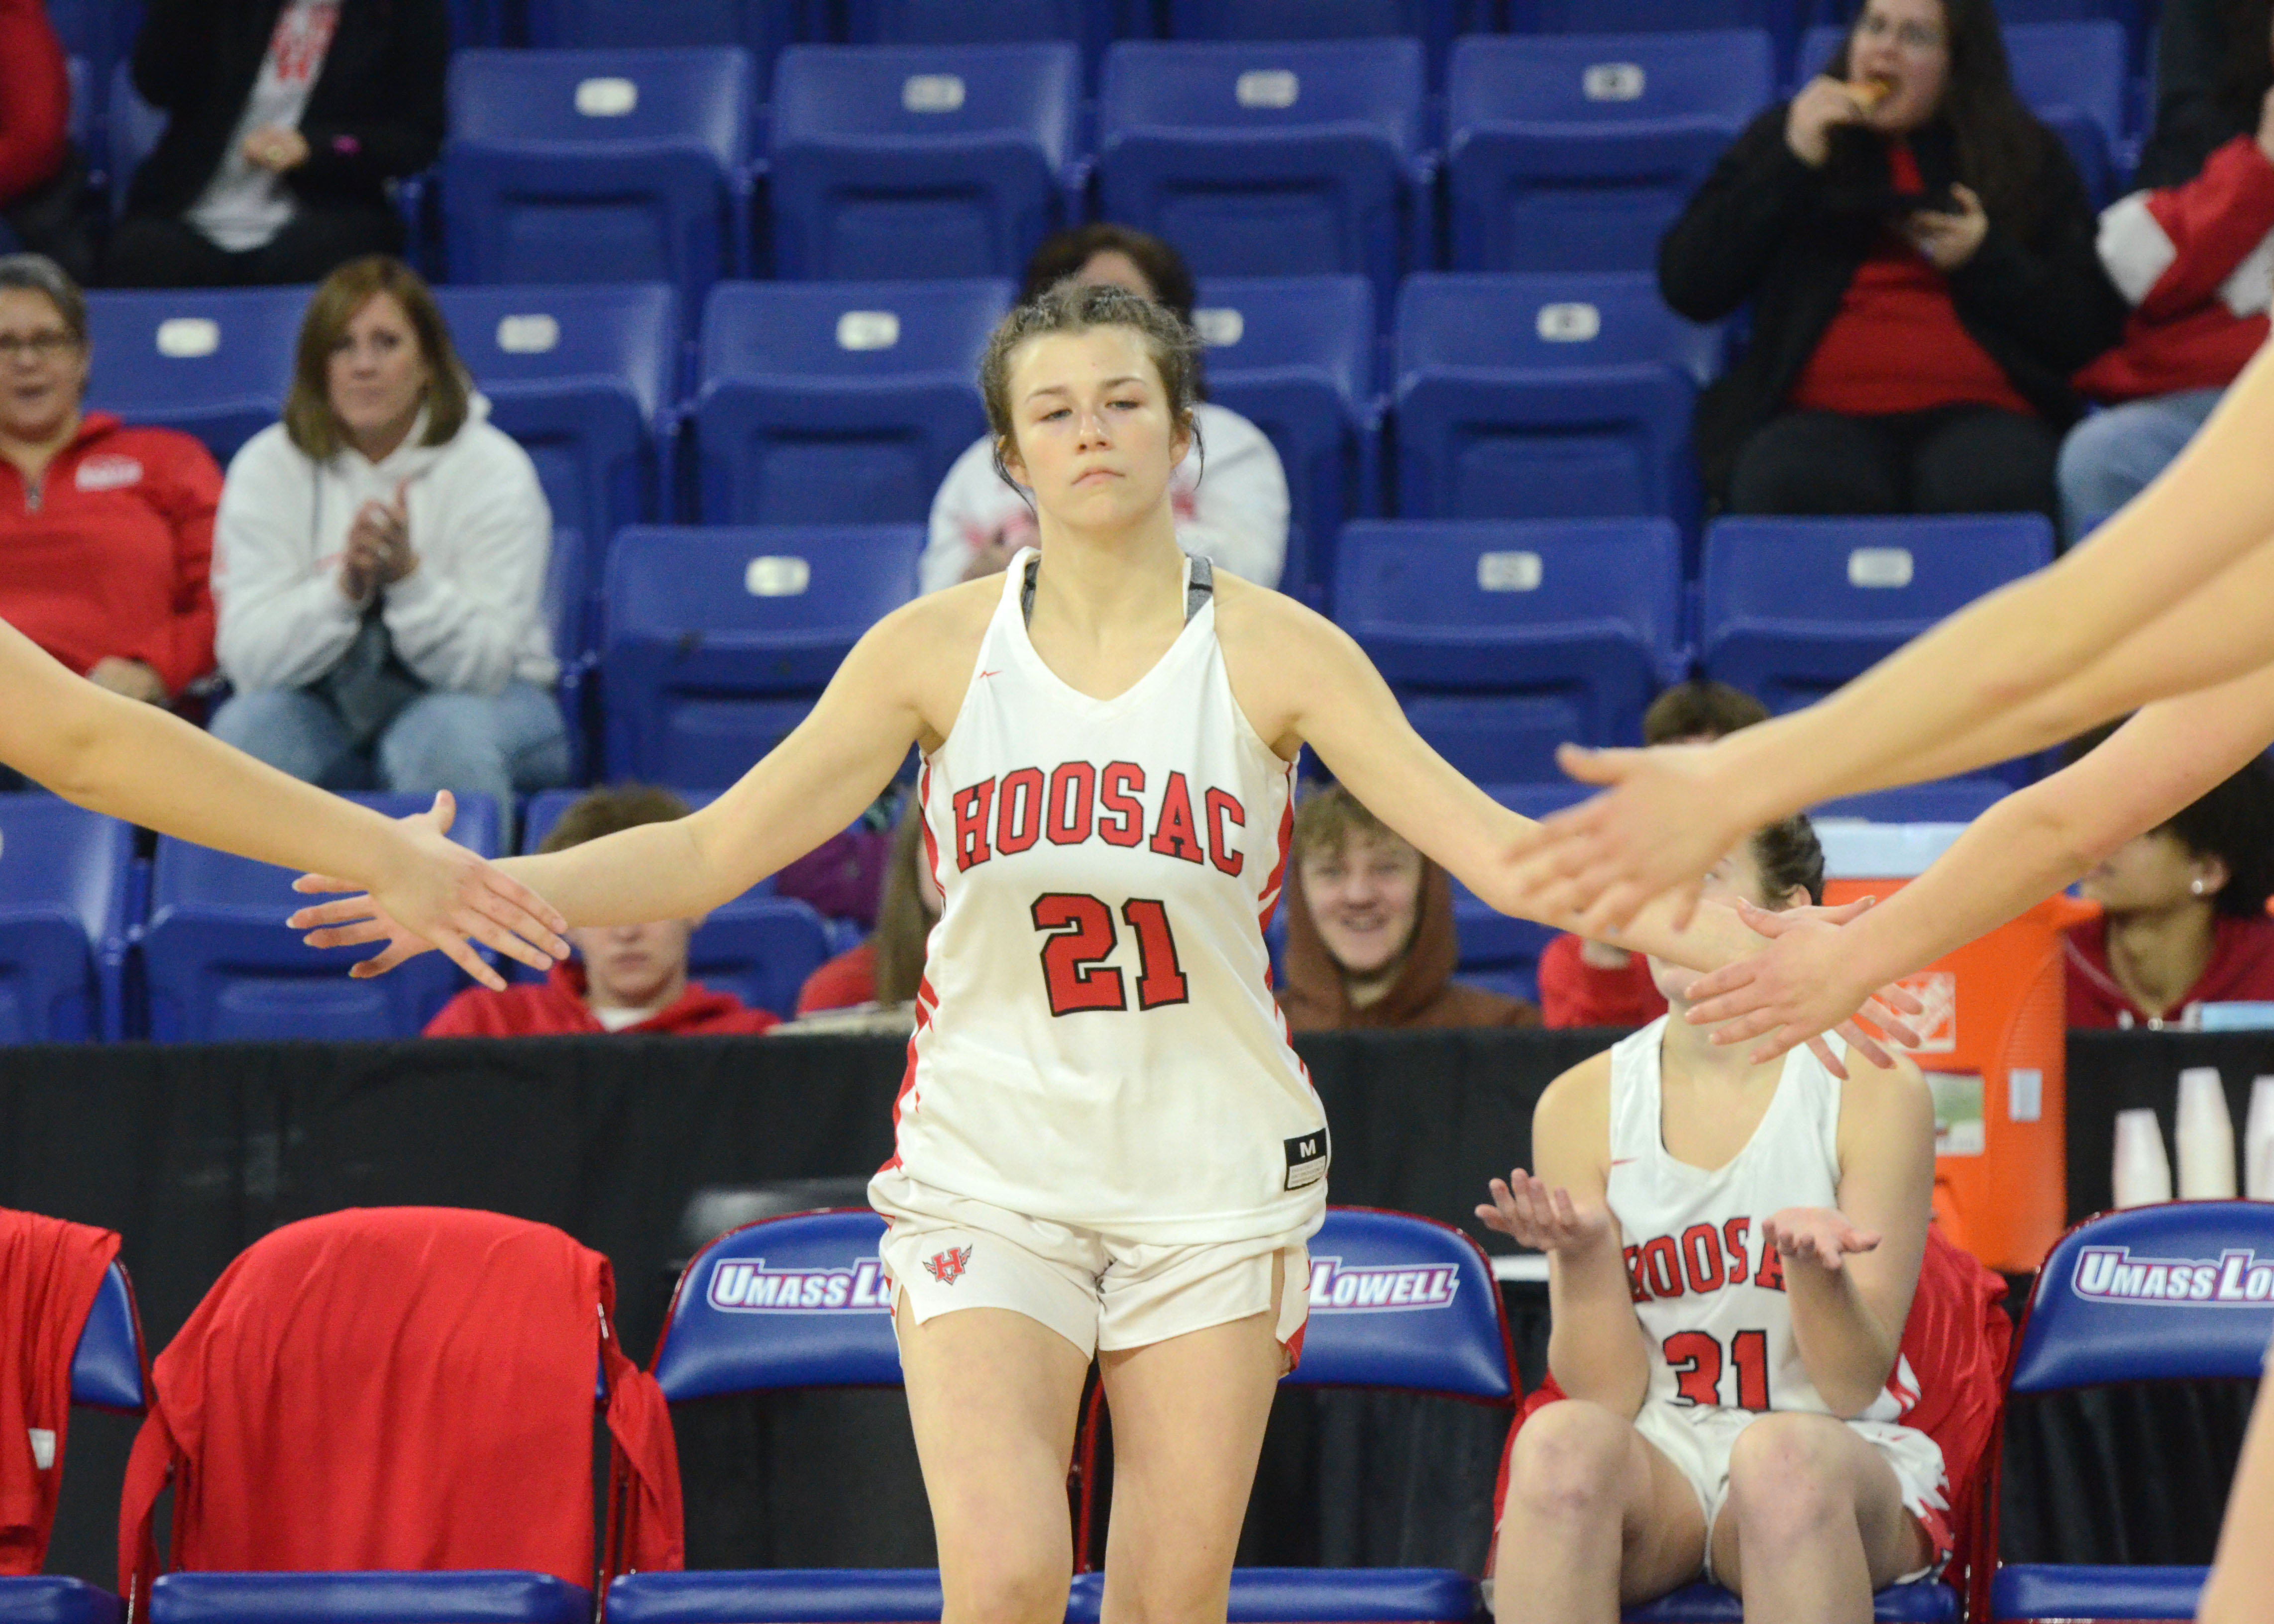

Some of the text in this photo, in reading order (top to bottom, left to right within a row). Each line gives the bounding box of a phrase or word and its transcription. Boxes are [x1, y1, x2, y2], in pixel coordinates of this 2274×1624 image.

[953, 760, 1245, 877] HOOSAC
[1030, 892, 1189, 1017] 21
[1299, 1138, 1316, 1158] M
[932, 1247, 965, 1283] H
[2217, 1255, 2274, 1302] LO
[1662, 1329, 1771, 1412] 31
